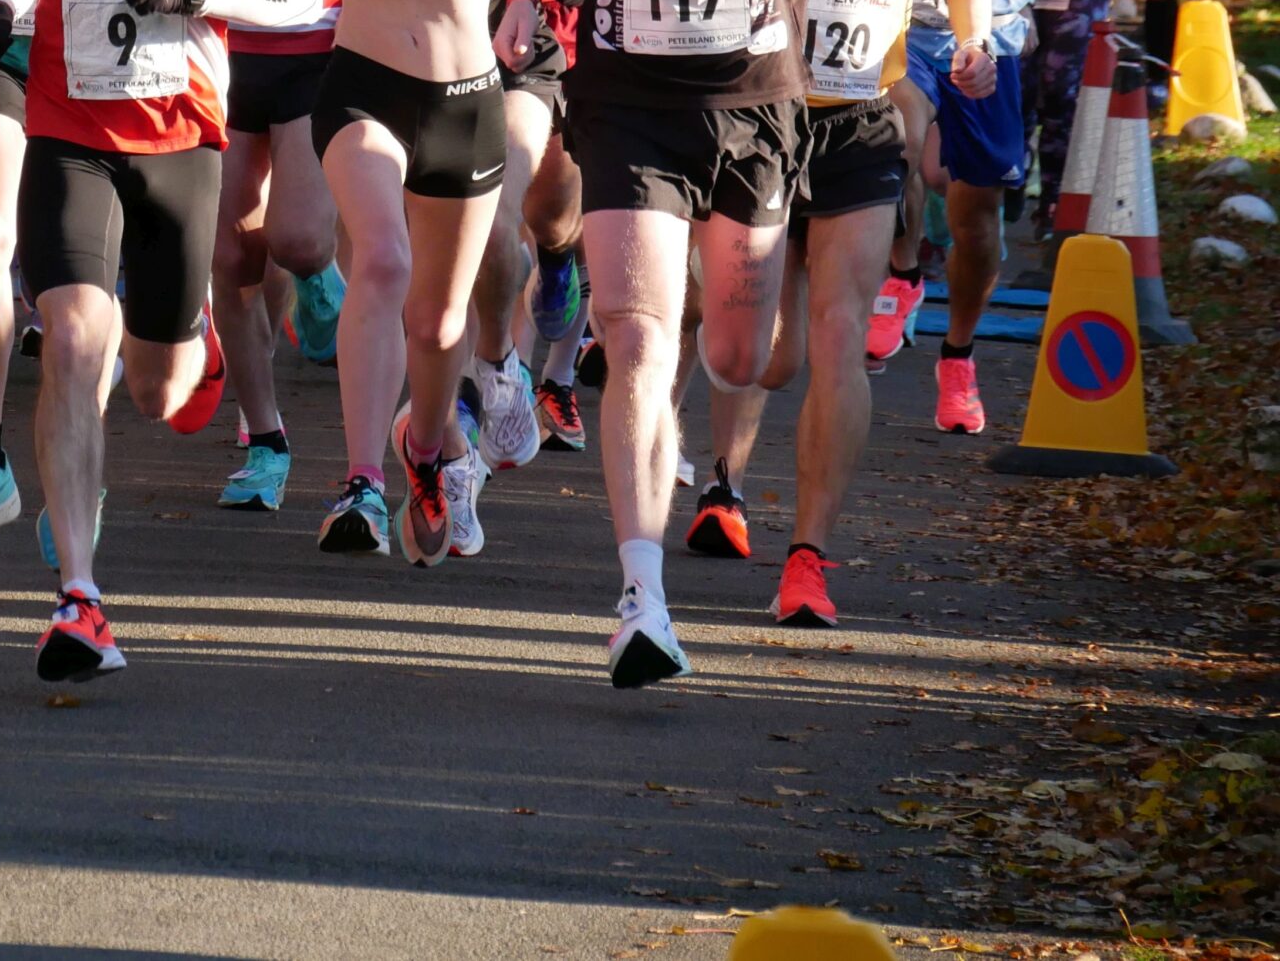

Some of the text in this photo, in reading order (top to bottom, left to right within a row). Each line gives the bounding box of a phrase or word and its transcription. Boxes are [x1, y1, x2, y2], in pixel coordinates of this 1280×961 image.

[107, 12, 138, 67] 9
[639, 32, 747, 47] Aegis PETE BLAND SPORTS
[804, 18, 871, 71] 120
[108, 80, 126, 89] PETE
[445, 77, 488, 97] NIKE
